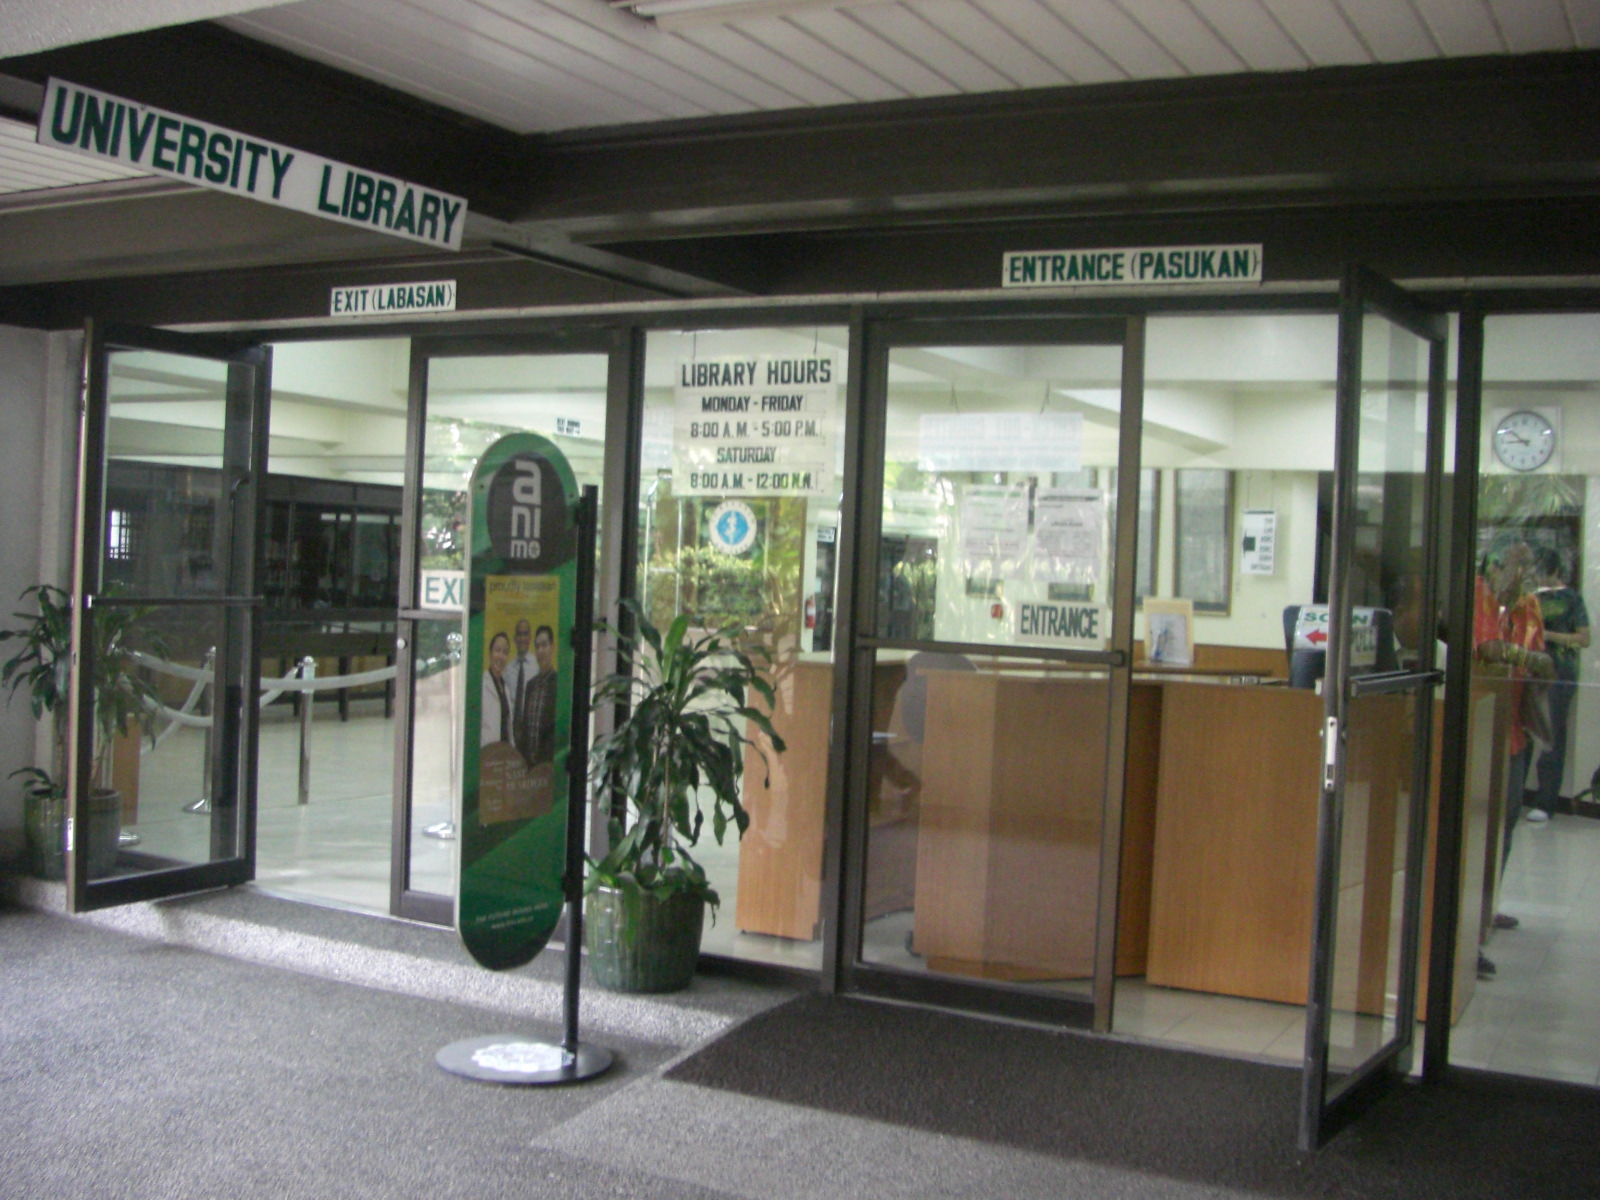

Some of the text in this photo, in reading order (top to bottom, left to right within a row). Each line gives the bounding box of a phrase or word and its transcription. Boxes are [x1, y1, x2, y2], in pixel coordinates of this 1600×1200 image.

[52, 86, 462, 244] UNIVERSITY LIBRARY
[1009, 249, 1258, 283] ENTRANCE (PASUKAN)
[334, 283, 452, 312] EXIT (LABASAN)
[681, 358, 832, 388] LIBRARY HOURS
[701, 396, 751, 413] MONDAY
[761, 395, 804, 411] FRIDAY
[690, 421, 720, 438] 8:00
[761, 420, 791, 437] 5:00
[716, 446, 777, 464] SATURDAY
[690, 472, 719, 489] 8:00
[756, 472, 789, 489] 12:00
[425, 576, 465, 606] EXI
[1020, 604, 1099, 639] ENTRANCE
